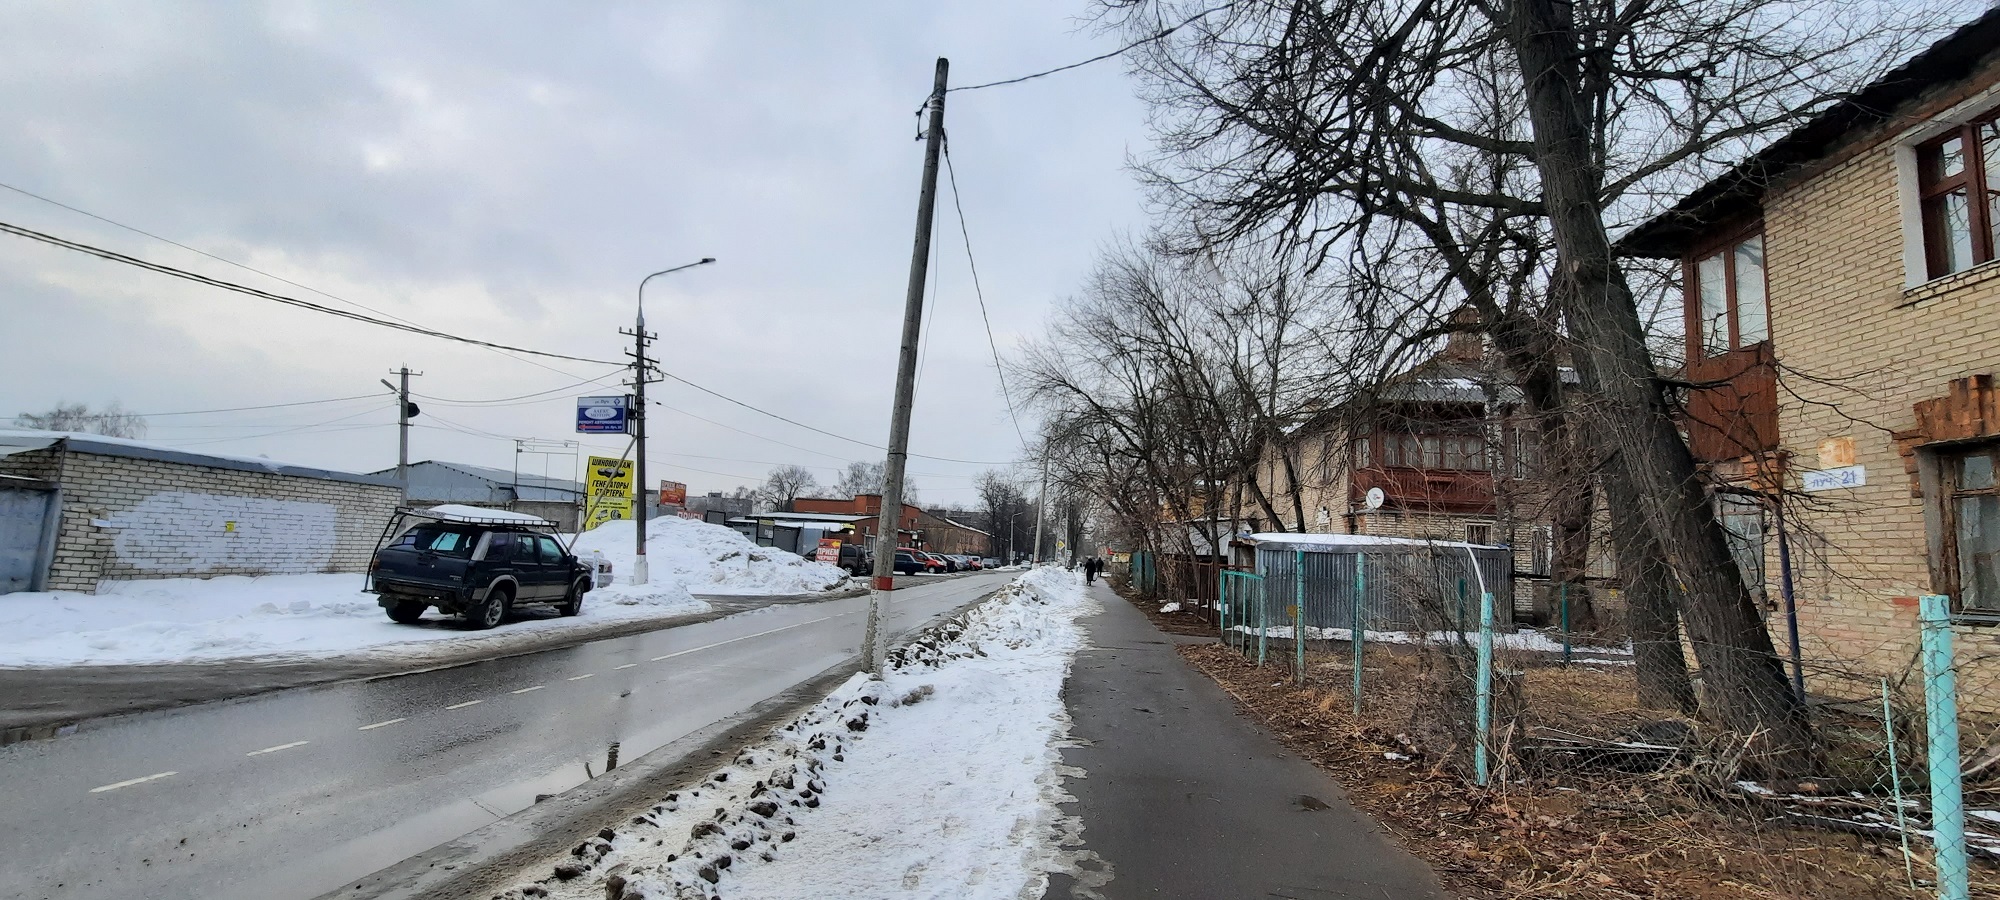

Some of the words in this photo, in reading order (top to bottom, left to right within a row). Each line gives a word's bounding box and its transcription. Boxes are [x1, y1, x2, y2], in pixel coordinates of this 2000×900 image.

[592, 459, 632, 469] ШИНОМОАЖ
[1842, 470, 1856, 484] 21
[592, 480, 630, 490] ГЕНЕАТОРЫ
[817, 547, 840, 555] ПРИЕМ
